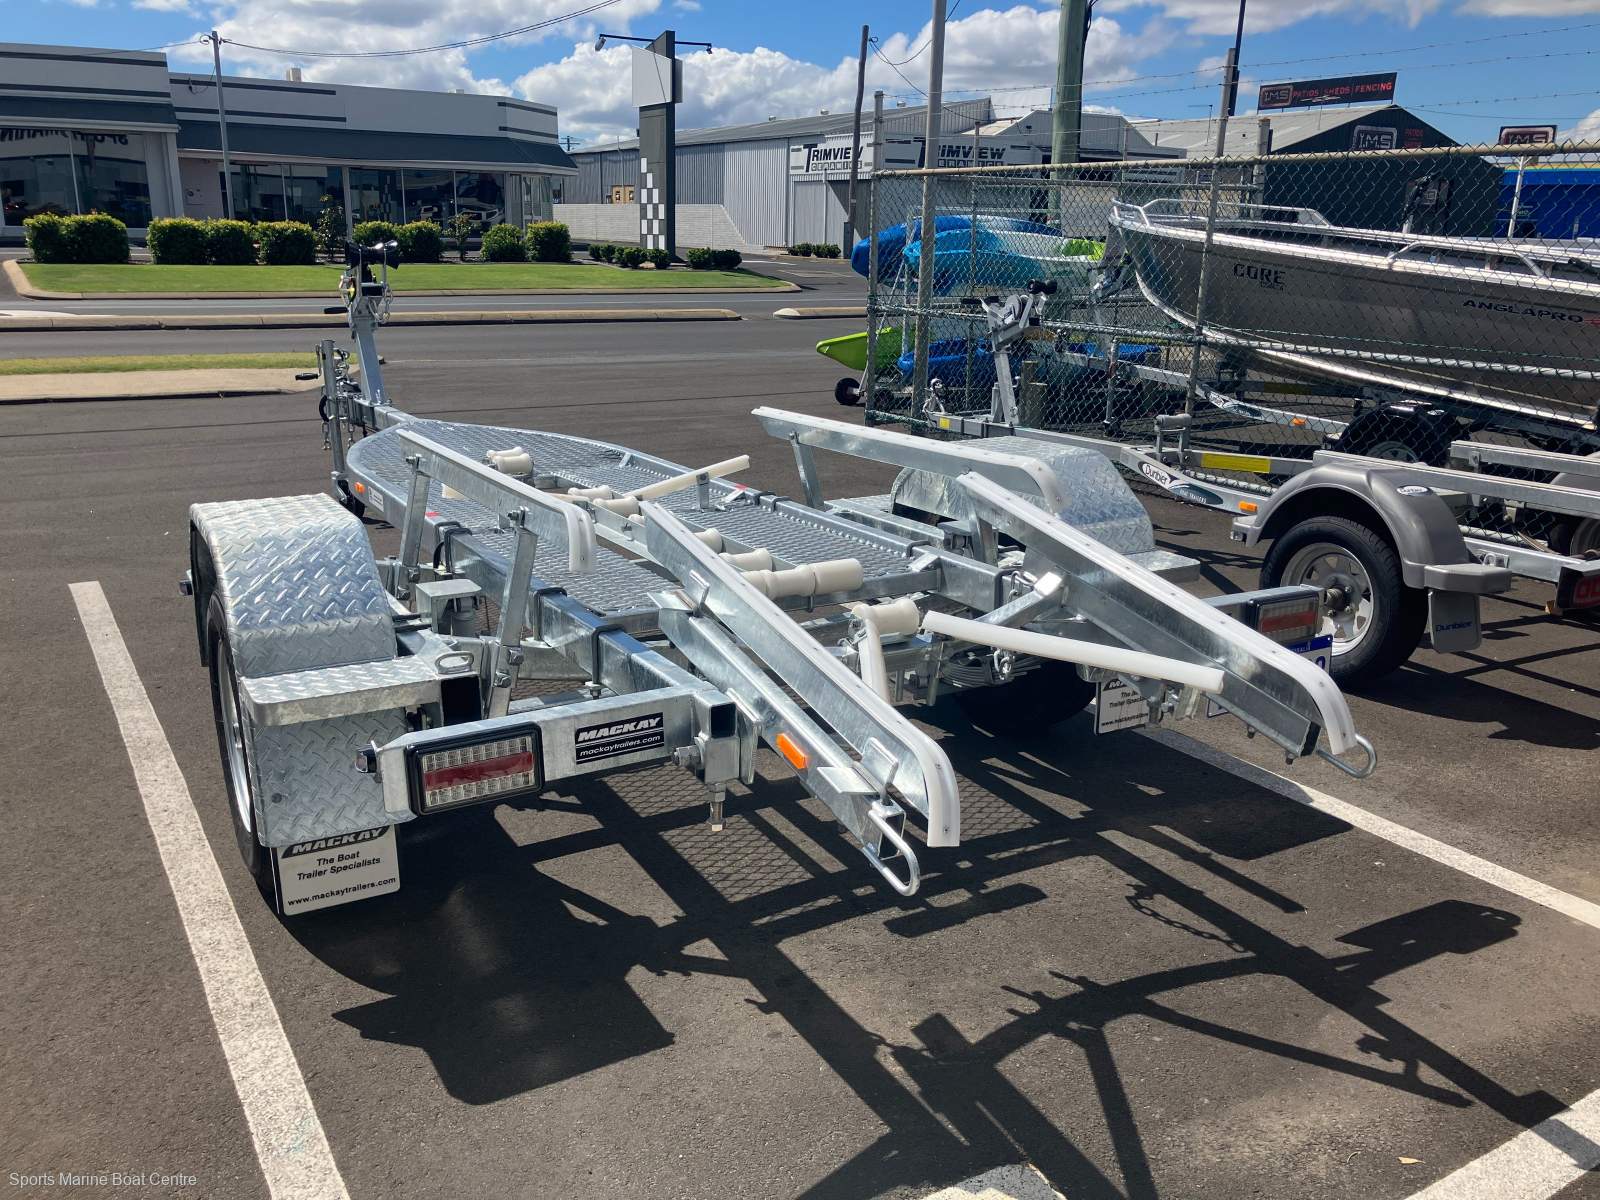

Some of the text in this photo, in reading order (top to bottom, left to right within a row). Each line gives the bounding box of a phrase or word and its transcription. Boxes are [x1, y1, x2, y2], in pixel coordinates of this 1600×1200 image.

[1355, 82, 1392, 93] FENCING
[1233, 263, 1286, 284] CORE
[1463, 300, 1584, 322] ANGLAPRO
[1435, 621, 1473, 632] Dunbier
[578, 717, 661, 741] MACKAY
[580, 735, 661, 756] mackaytrailers.com
[292, 828, 384, 854] MACKAY
[297, 857, 381, 881] Trailer Specialists
[317, 851, 361, 867] The Boat
[288, 877, 396, 906] www.mackaytrailers.com
